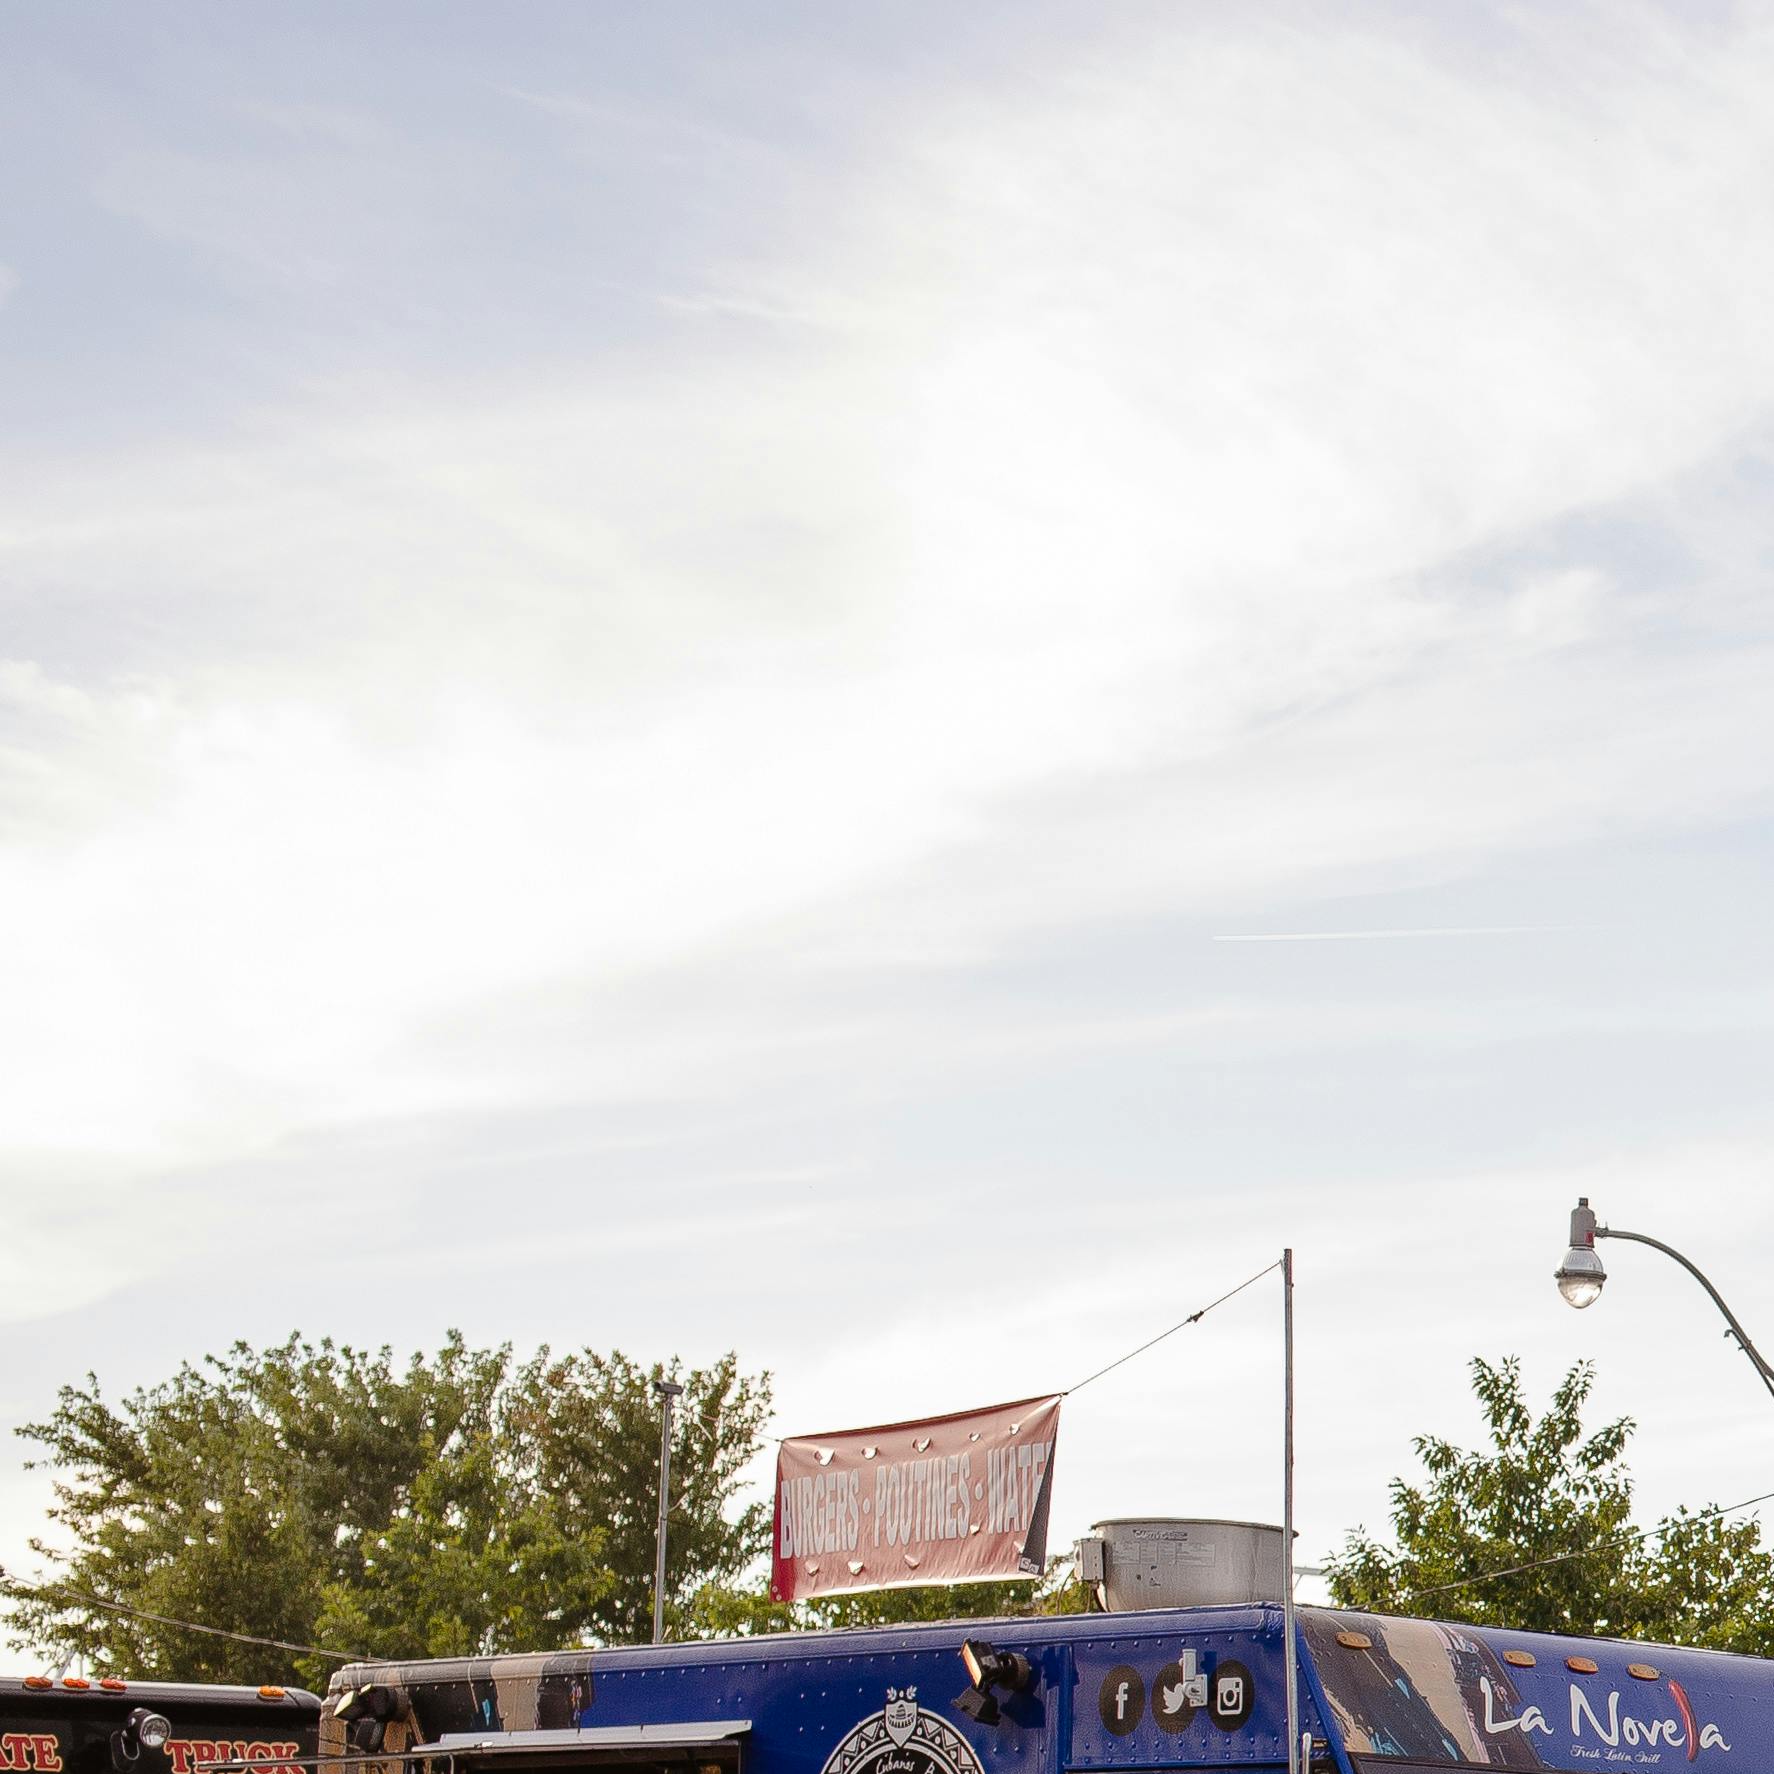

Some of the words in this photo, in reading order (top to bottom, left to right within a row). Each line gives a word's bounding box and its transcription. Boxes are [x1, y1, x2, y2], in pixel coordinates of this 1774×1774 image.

[780, 1469, 860, 1559] BURGERS
[874, 1453, 971, 1547] POUTINES
[987, 1440, 1054, 1534] WATE
[1480, 1676, 1554, 1735] La
